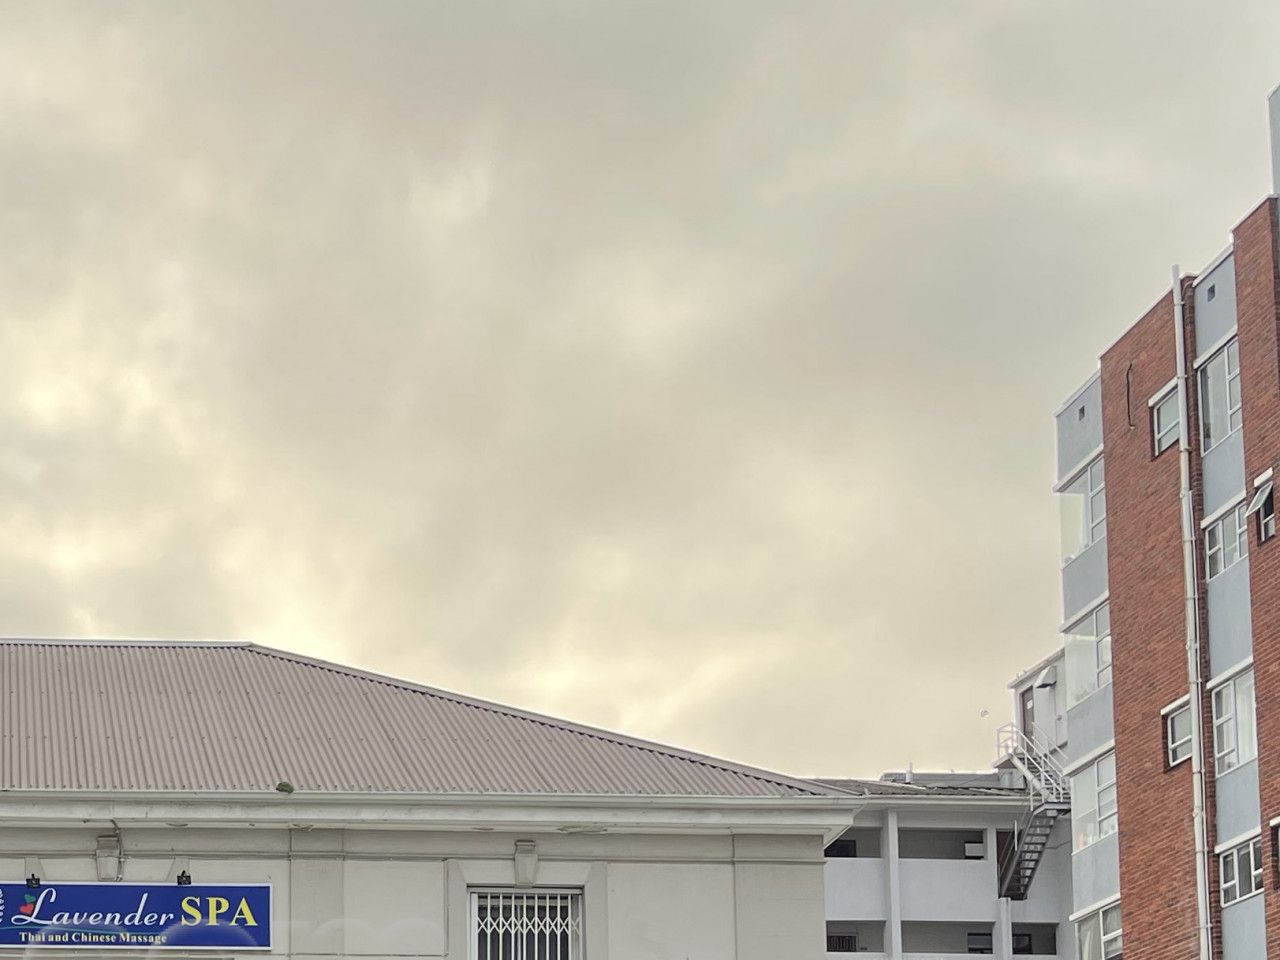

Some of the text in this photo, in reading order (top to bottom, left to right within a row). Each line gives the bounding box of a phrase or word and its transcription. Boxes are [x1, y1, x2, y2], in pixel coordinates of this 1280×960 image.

[11, 888, 258, 927] Lavender SPA
[19, 932, 167, 944] Thai and Chinese Massage
